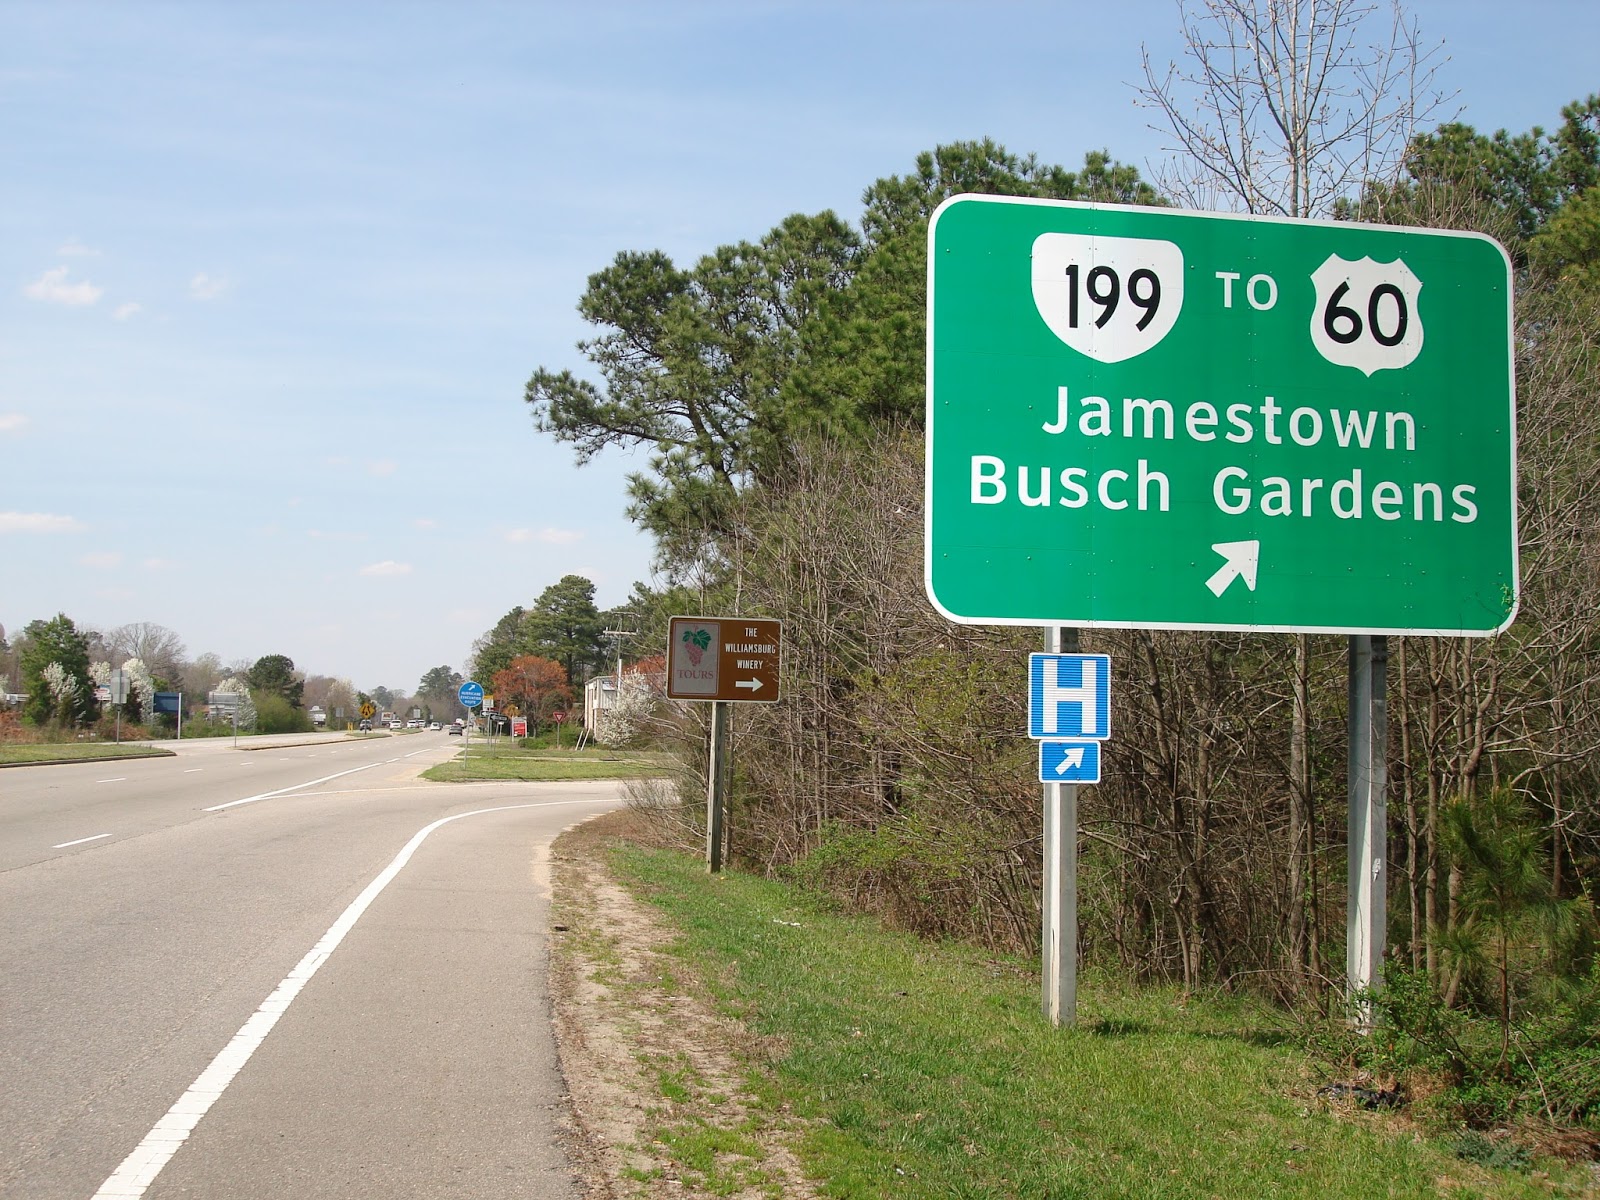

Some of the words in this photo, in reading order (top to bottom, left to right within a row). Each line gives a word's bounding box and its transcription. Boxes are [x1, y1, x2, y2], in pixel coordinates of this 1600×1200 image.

[1065, 264, 1161, 332] 199
[1215, 271, 1279, 312] TO
[1323, 280, 1408, 348] 60
[1042, 386, 1417, 451] Jamestown
[970, 455, 1170, 512] Busch
[1212, 466, 1479, 524] Gardens
[725, 643, 776, 654] WILLIAMSBURG
[745, 627, 758, 637] THE
[677, 669, 714, 680] TOURS
[737, 659, 764, 670] WINERY
[1042, 659, 1097, 734] H
